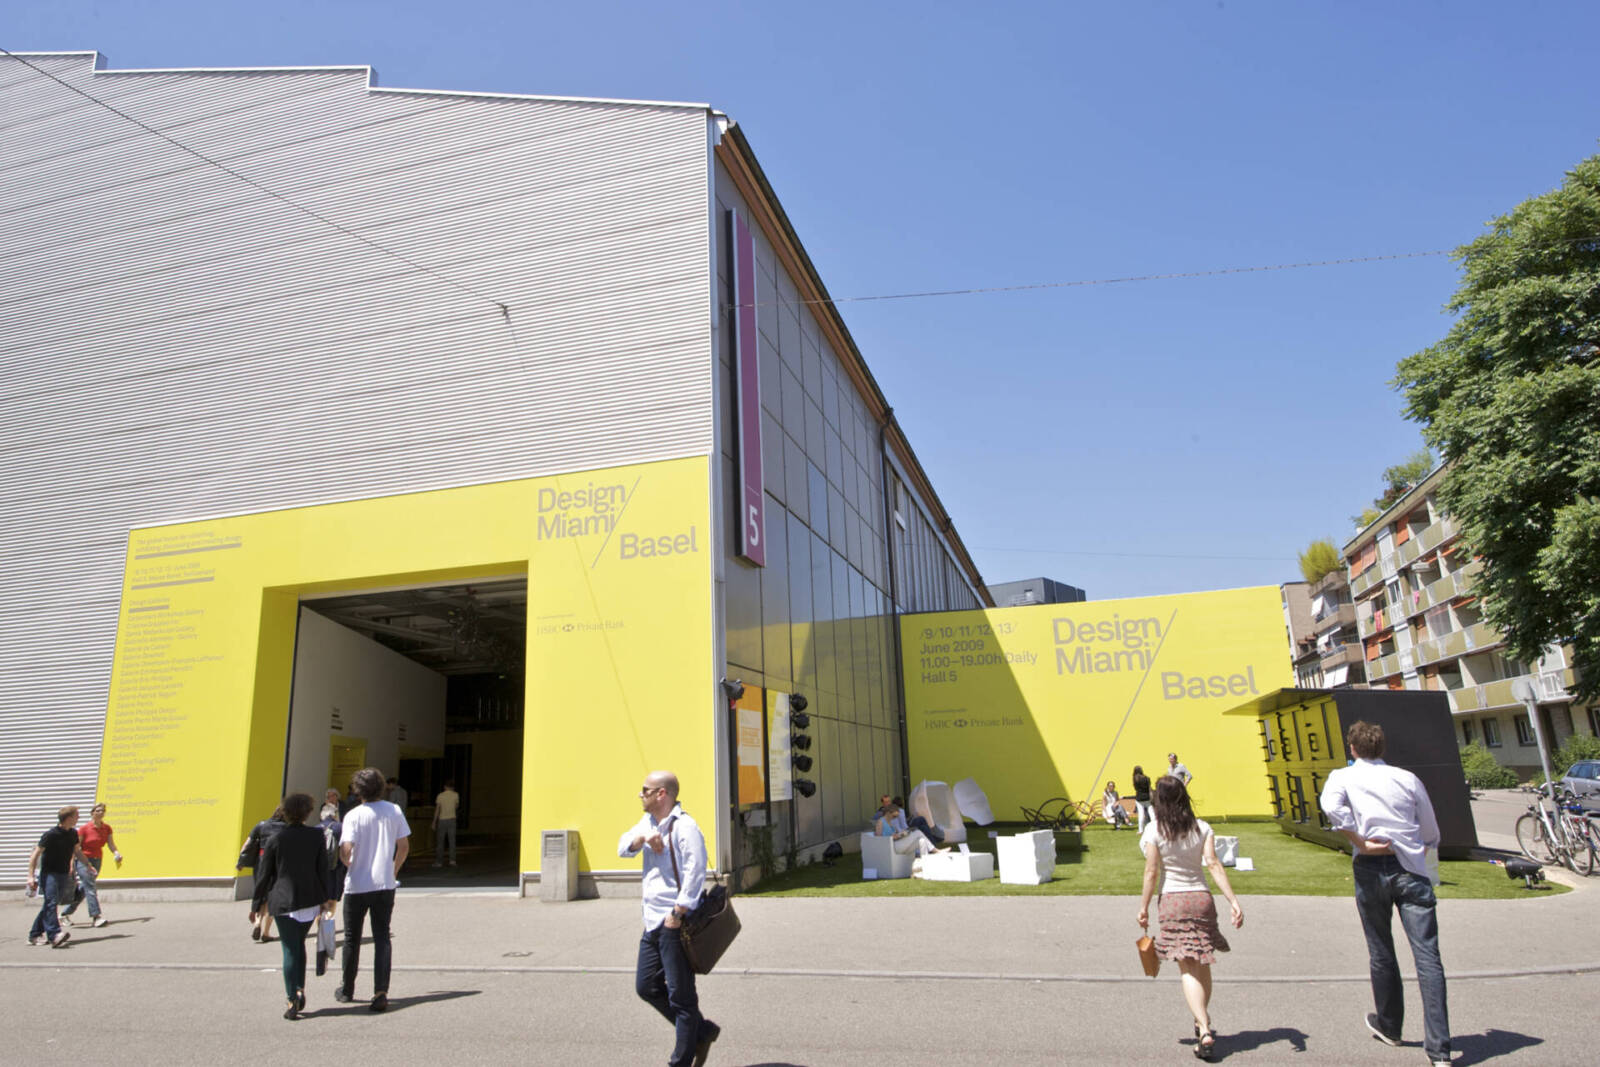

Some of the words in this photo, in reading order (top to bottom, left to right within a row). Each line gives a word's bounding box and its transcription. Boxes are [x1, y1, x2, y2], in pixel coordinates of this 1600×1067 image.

[537, 482, 626, 514] Design
[536, 506, 615, 541] Miami
[749, 504, 759, 547] 5
[619, 525, 698, 560] Basel
[920, 642, 950, 655] June
[953, 639, 985, 653] 2009
[1052, 611, 1163, 648] Design
[1005, 650, 1038, 665] Daily
[1055, 640, 1155, 675] Miami
[921, 671, 946, 684] Hall
[949, 670, 958, 682] 5
[1160, 665, 1259, 701] Basel
